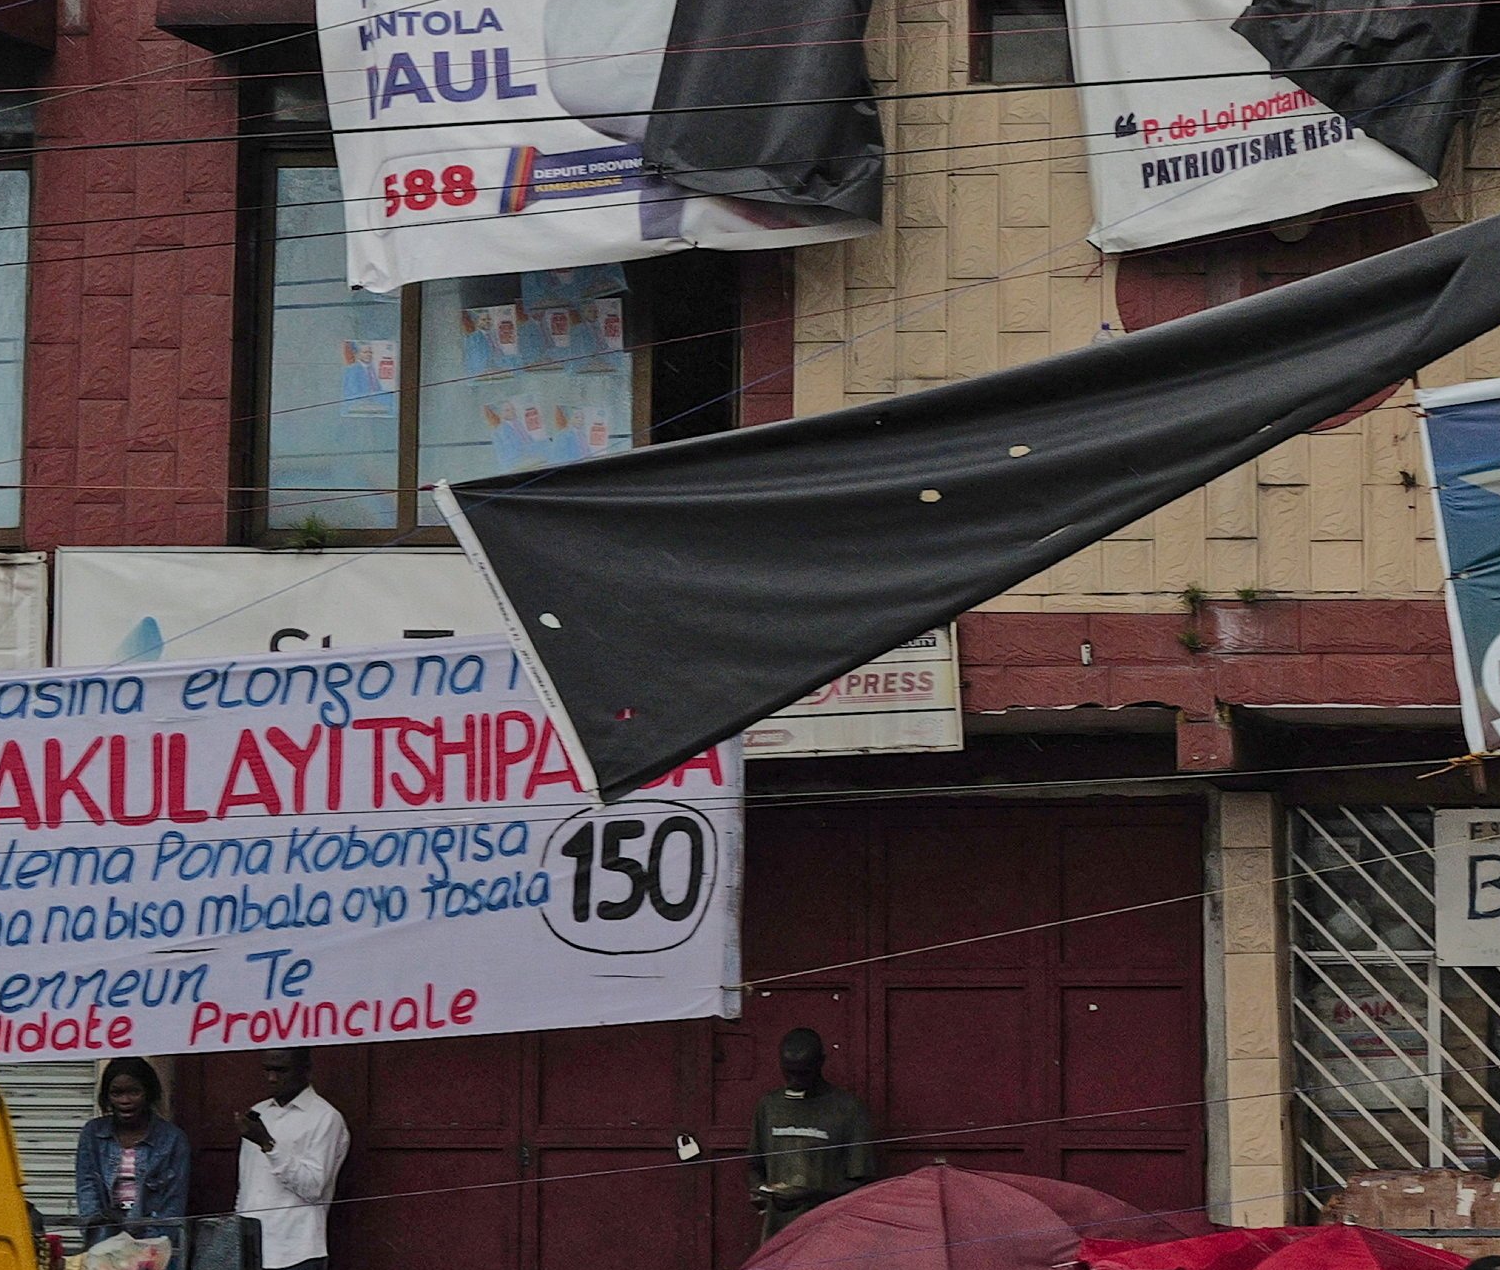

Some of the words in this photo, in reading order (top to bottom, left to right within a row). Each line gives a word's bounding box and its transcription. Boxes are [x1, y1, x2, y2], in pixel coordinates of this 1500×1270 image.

[1141, 129, 1296, 189] PATRIOTISME
[151, 831, 272, 881] Pona
[561, 816, 704, 922] 150
[198, 884, 331, 936] mbala
